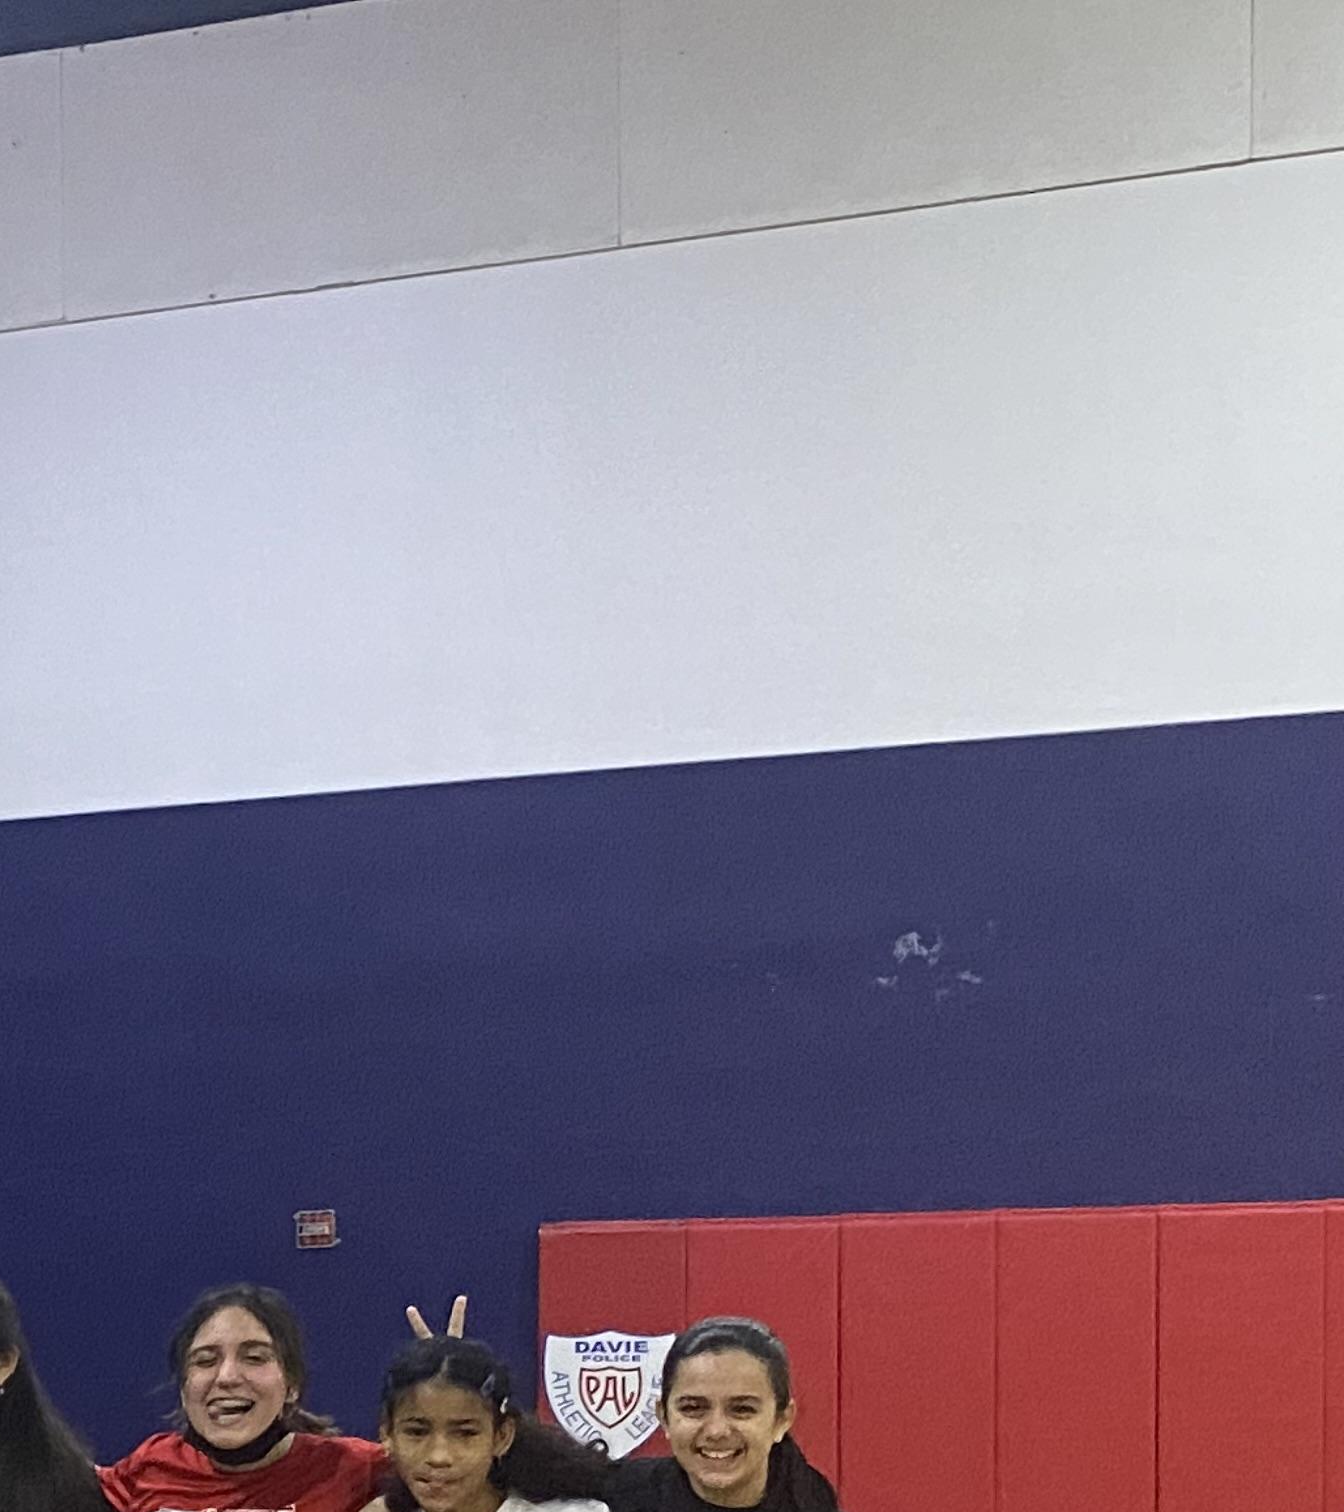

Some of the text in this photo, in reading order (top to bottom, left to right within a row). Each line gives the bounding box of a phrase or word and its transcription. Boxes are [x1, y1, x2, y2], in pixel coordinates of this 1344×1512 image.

[574, 1341, 649, 1354] DAVIE
[582, 1354, 641, 1363] POLICE
[551, 1370, 603, 1442] ATHLETIC
[585, 1375, 635, 1418] PAL
